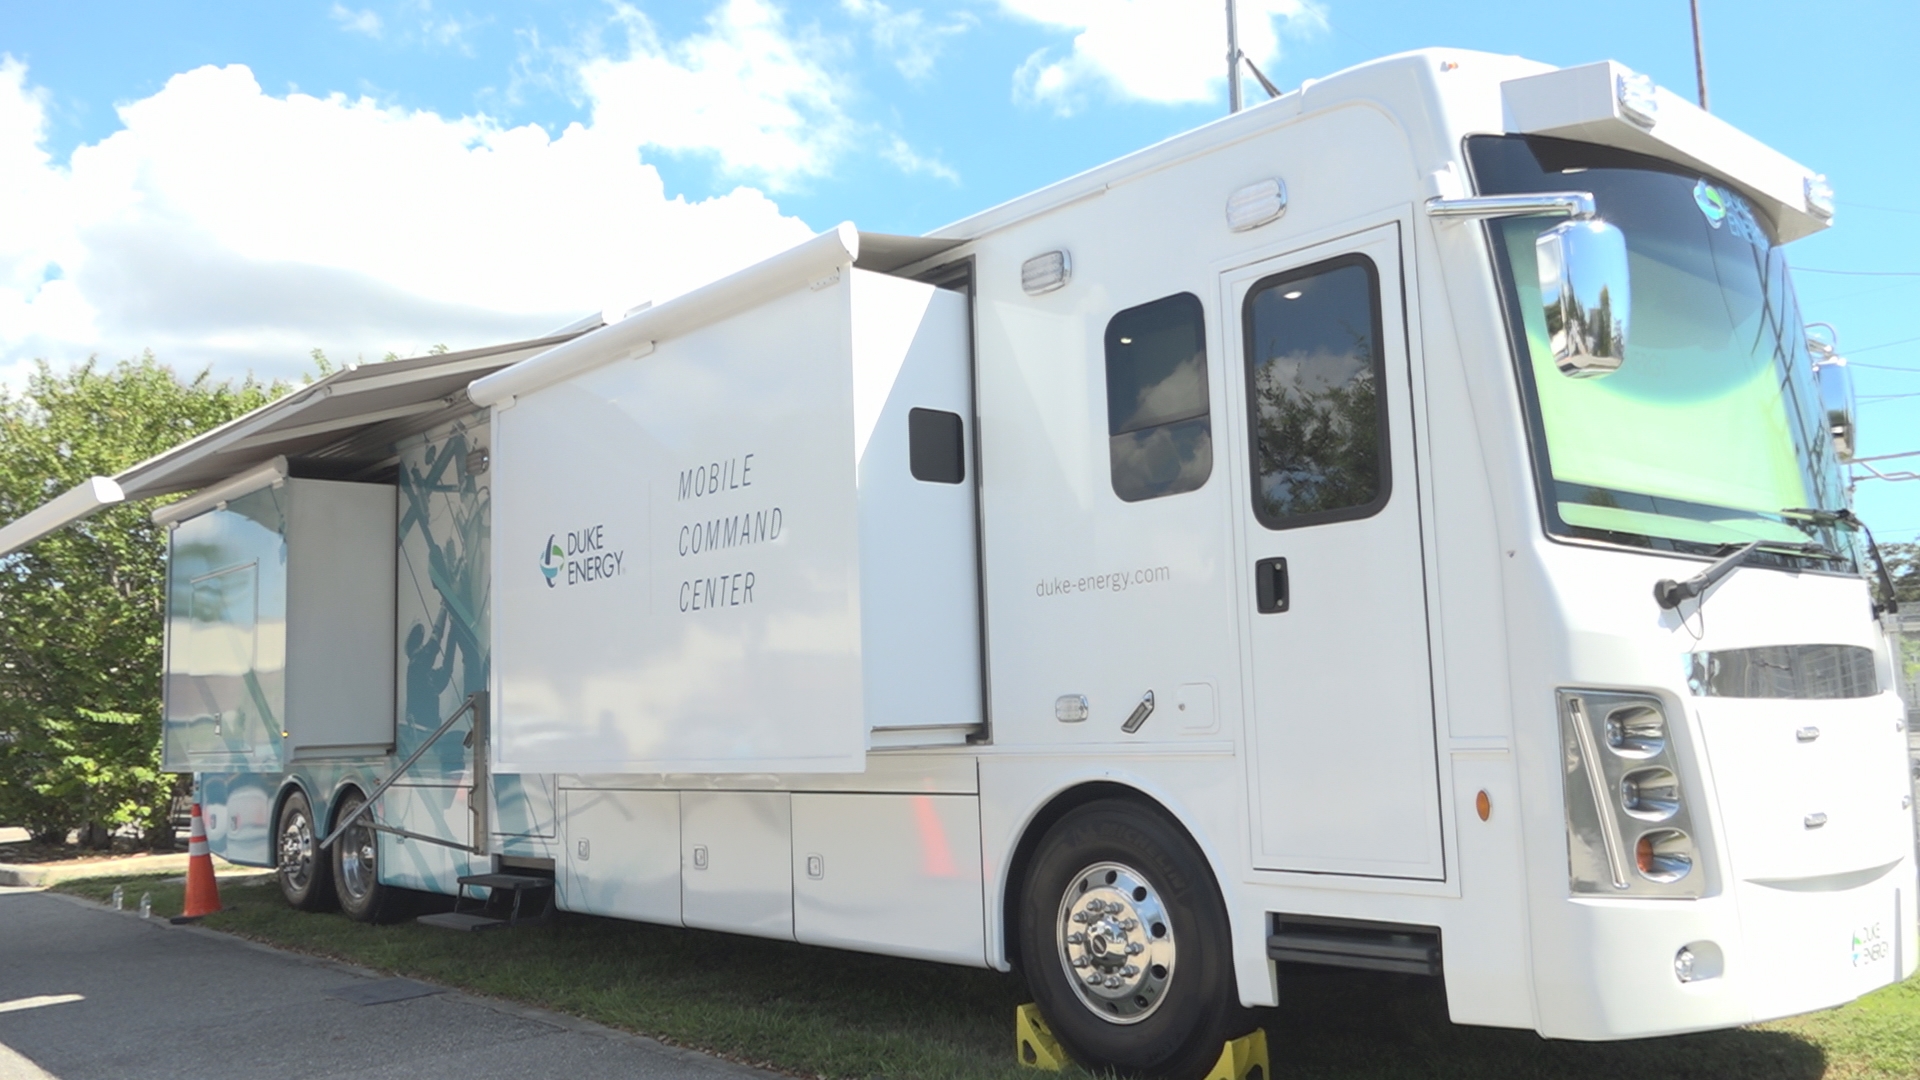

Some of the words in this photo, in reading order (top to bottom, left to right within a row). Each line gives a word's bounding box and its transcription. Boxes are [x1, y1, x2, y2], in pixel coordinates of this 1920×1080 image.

[677, 453, 754, 502] MOBILE
[567, 524, 604, 557] DUKE
[678, 507, 783, 557] COMMAND
[567, 549, 624, 586] ENERGY
[1036, 565, 1170, 597] duke-energy.com
[678, 571, 756, 613] CENTER
